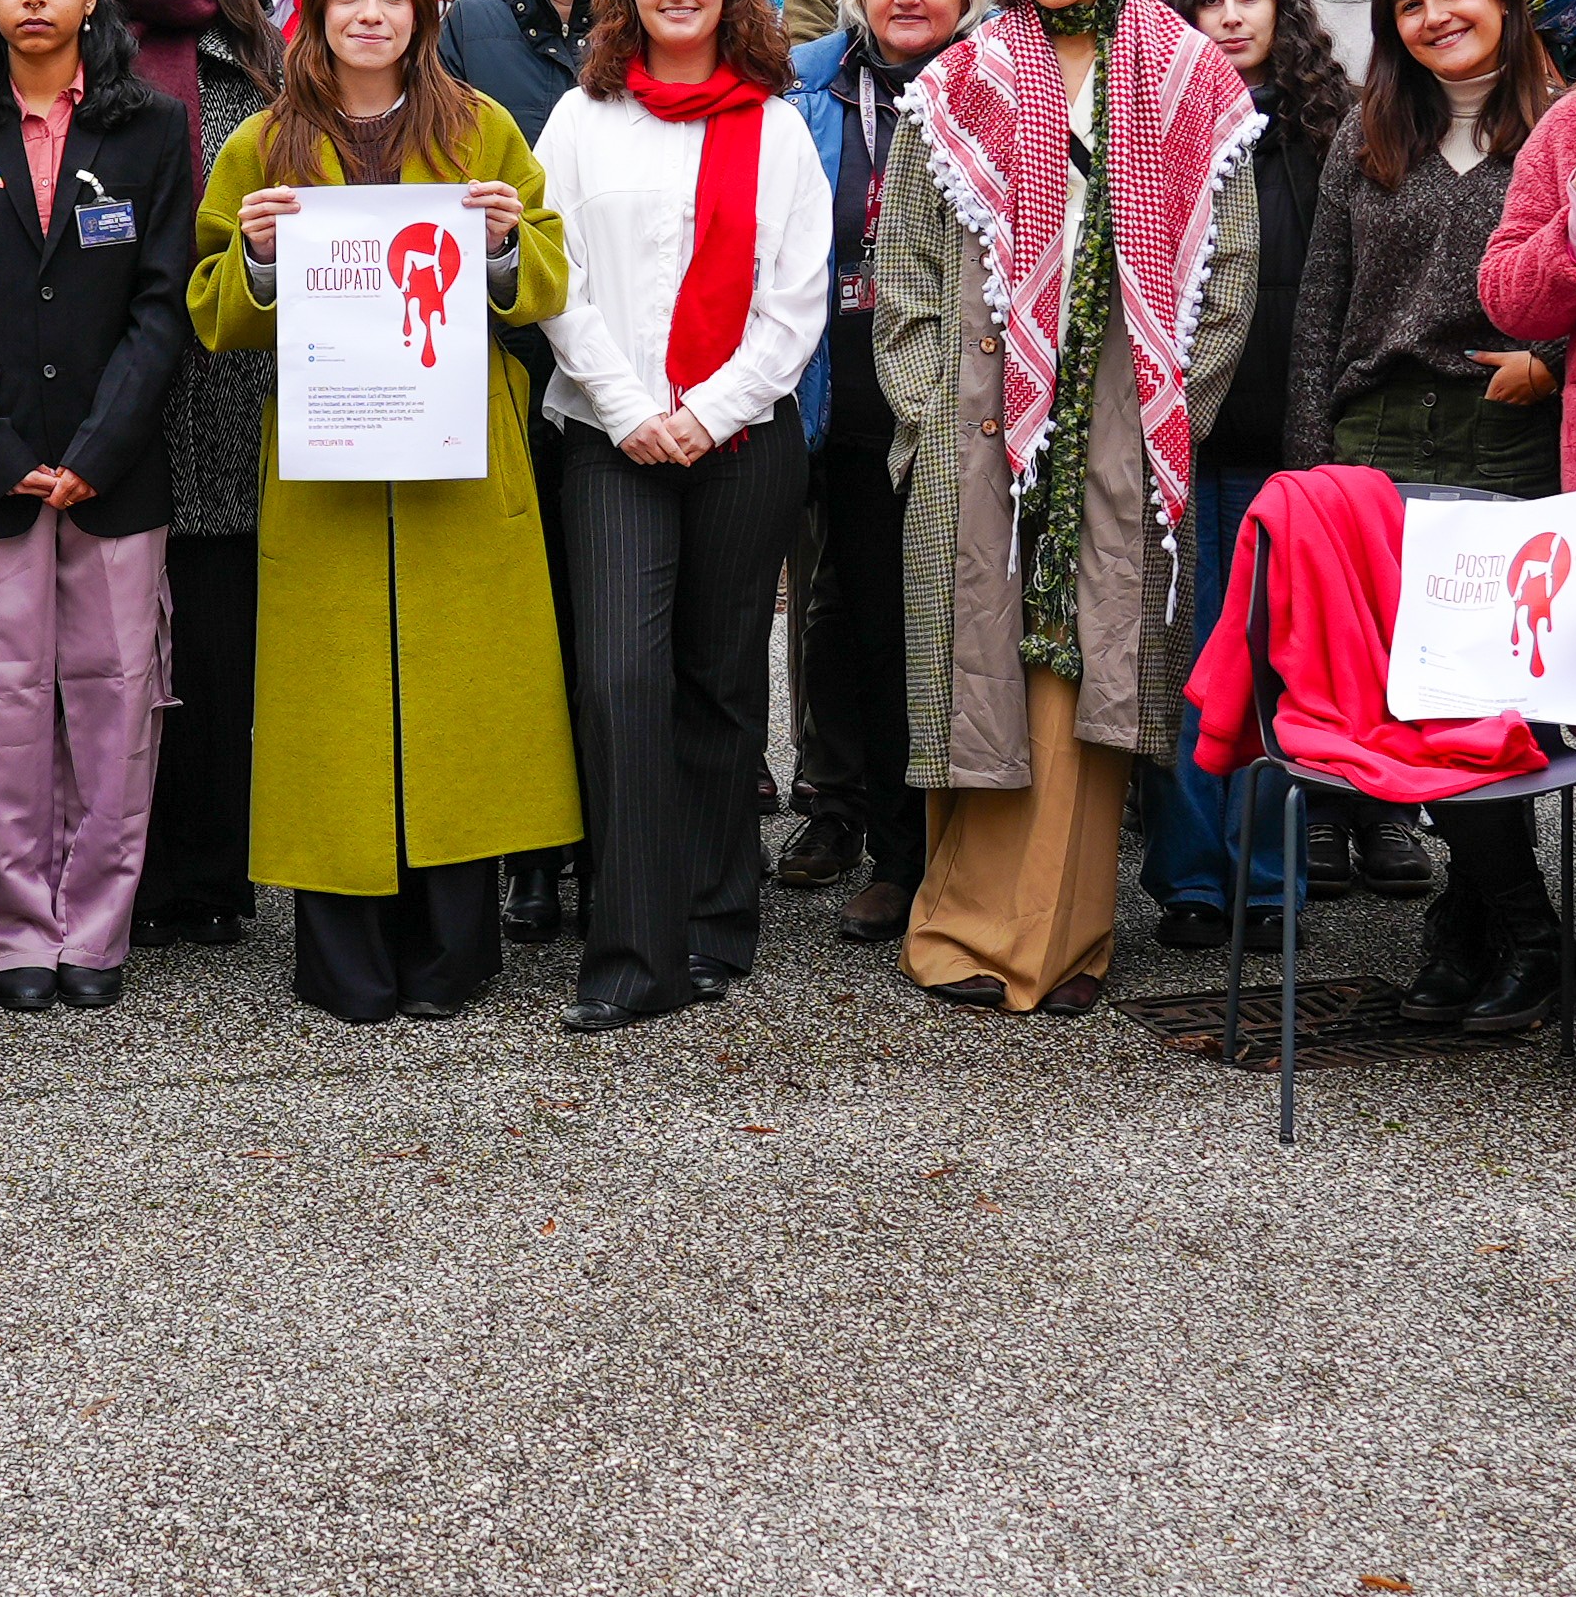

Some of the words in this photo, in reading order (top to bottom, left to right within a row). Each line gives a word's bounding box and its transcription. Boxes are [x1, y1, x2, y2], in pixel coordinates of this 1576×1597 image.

[331, 239, 381, 264] POSTO
[306, 267, 382, 292] OCCUPATO
[1455, 553, 1506, 577] POSTO
[1425, 574, 1500, 604] OCCUPATO
